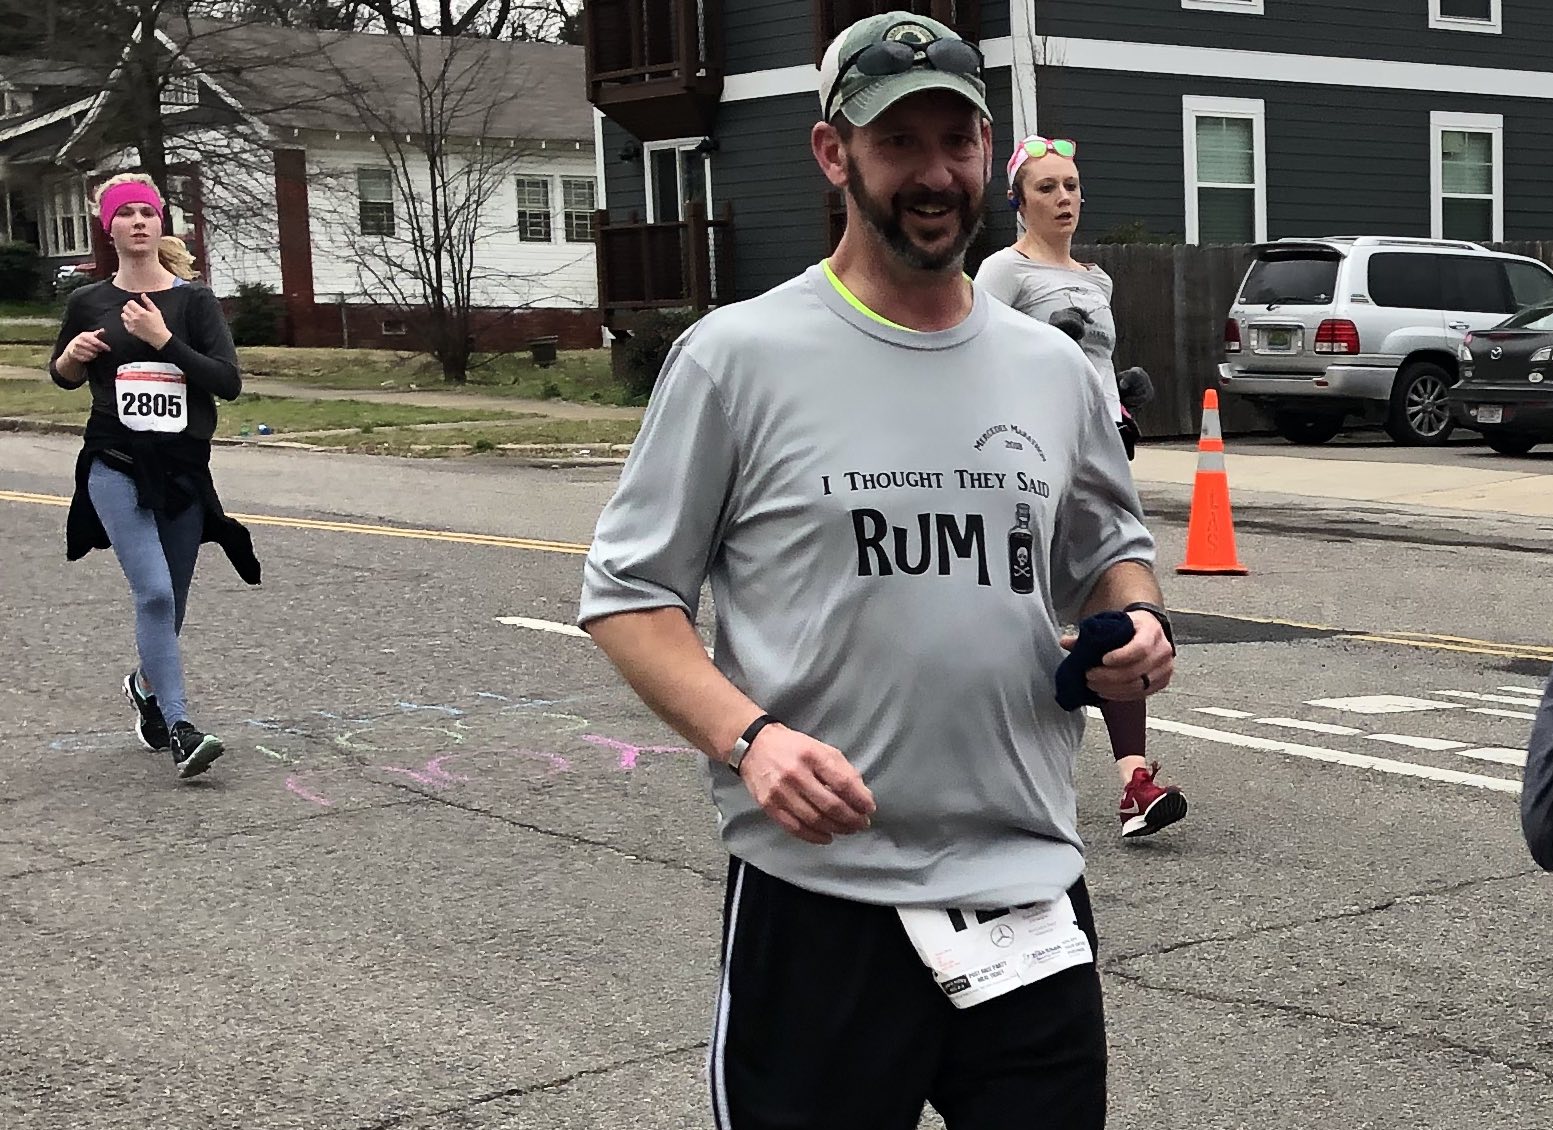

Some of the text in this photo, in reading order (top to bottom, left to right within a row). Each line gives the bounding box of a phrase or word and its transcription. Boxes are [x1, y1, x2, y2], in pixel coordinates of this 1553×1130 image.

[121, 392, 182, 418] 2805
[821, 469, 1050, 498] I THOUGHT THEY SAID
[851, 508, 992, 587] RUM
